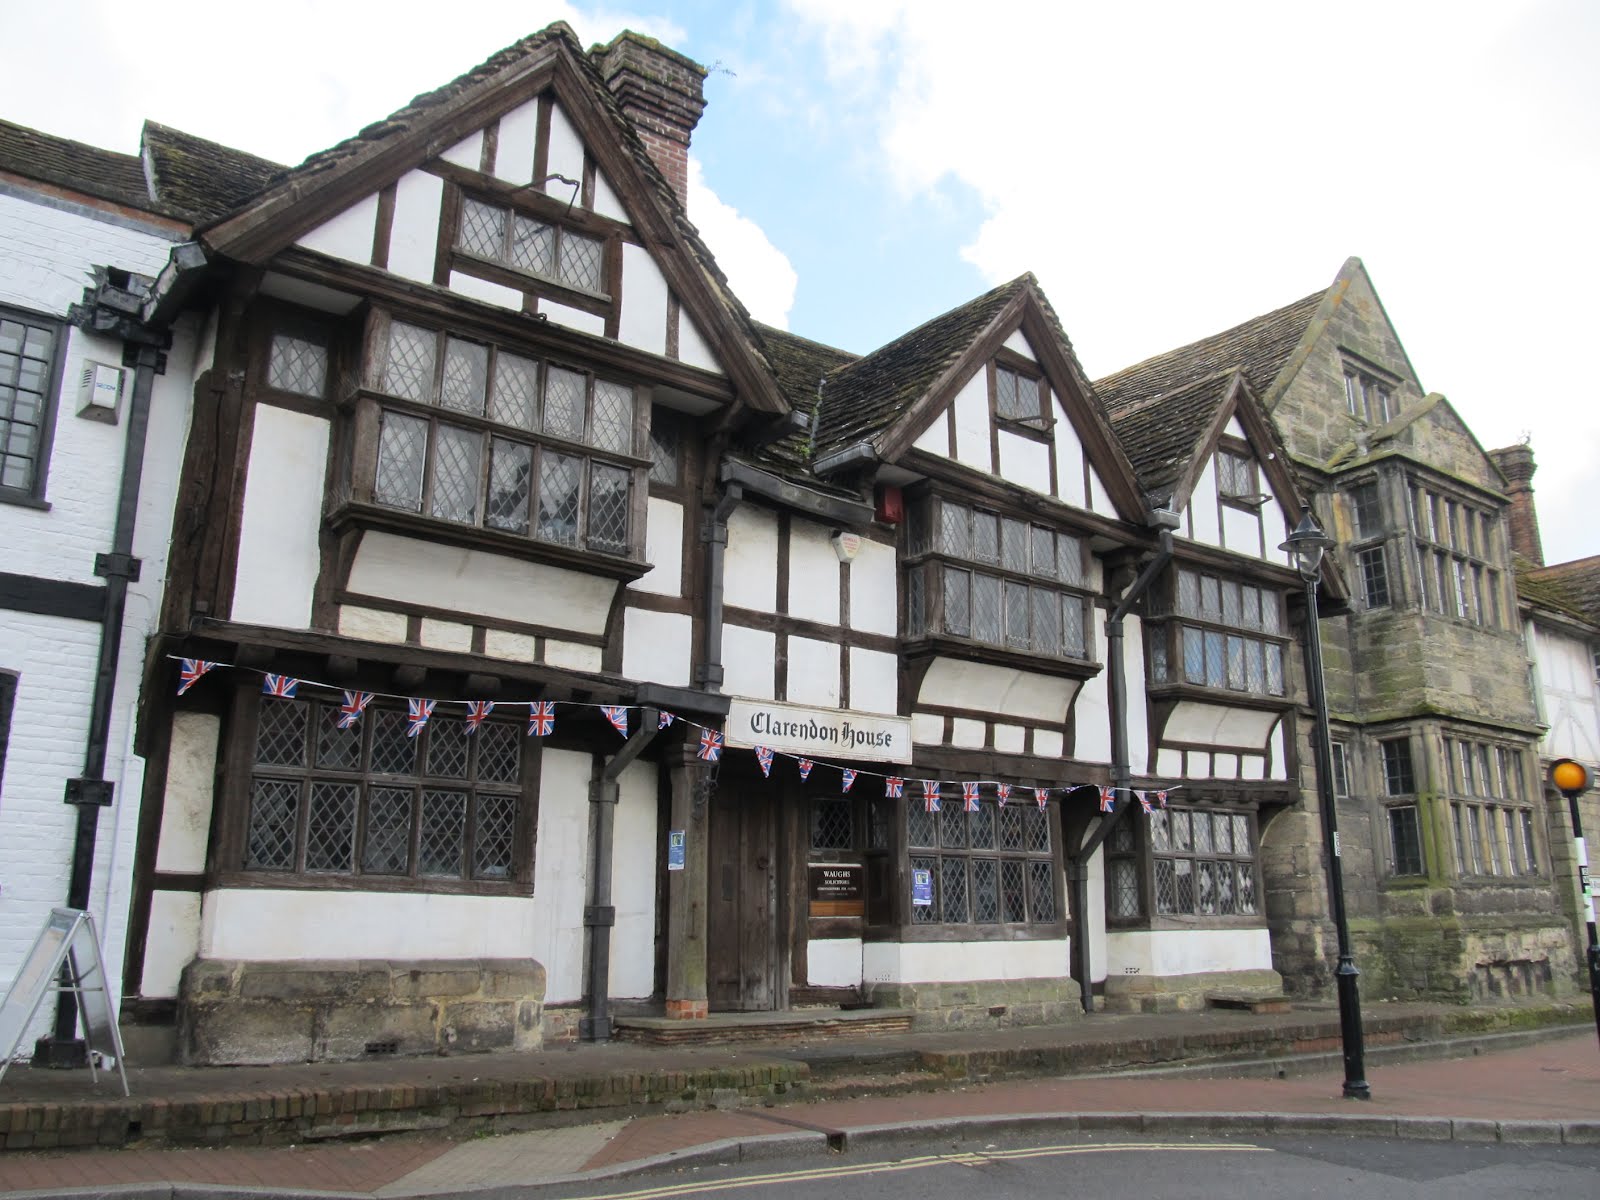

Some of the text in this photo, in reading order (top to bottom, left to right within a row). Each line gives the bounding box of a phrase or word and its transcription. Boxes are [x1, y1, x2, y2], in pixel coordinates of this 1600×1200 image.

[750, 711, 893, 749] Clarendon House
[823, 870, 850, 878] WAUGHS
